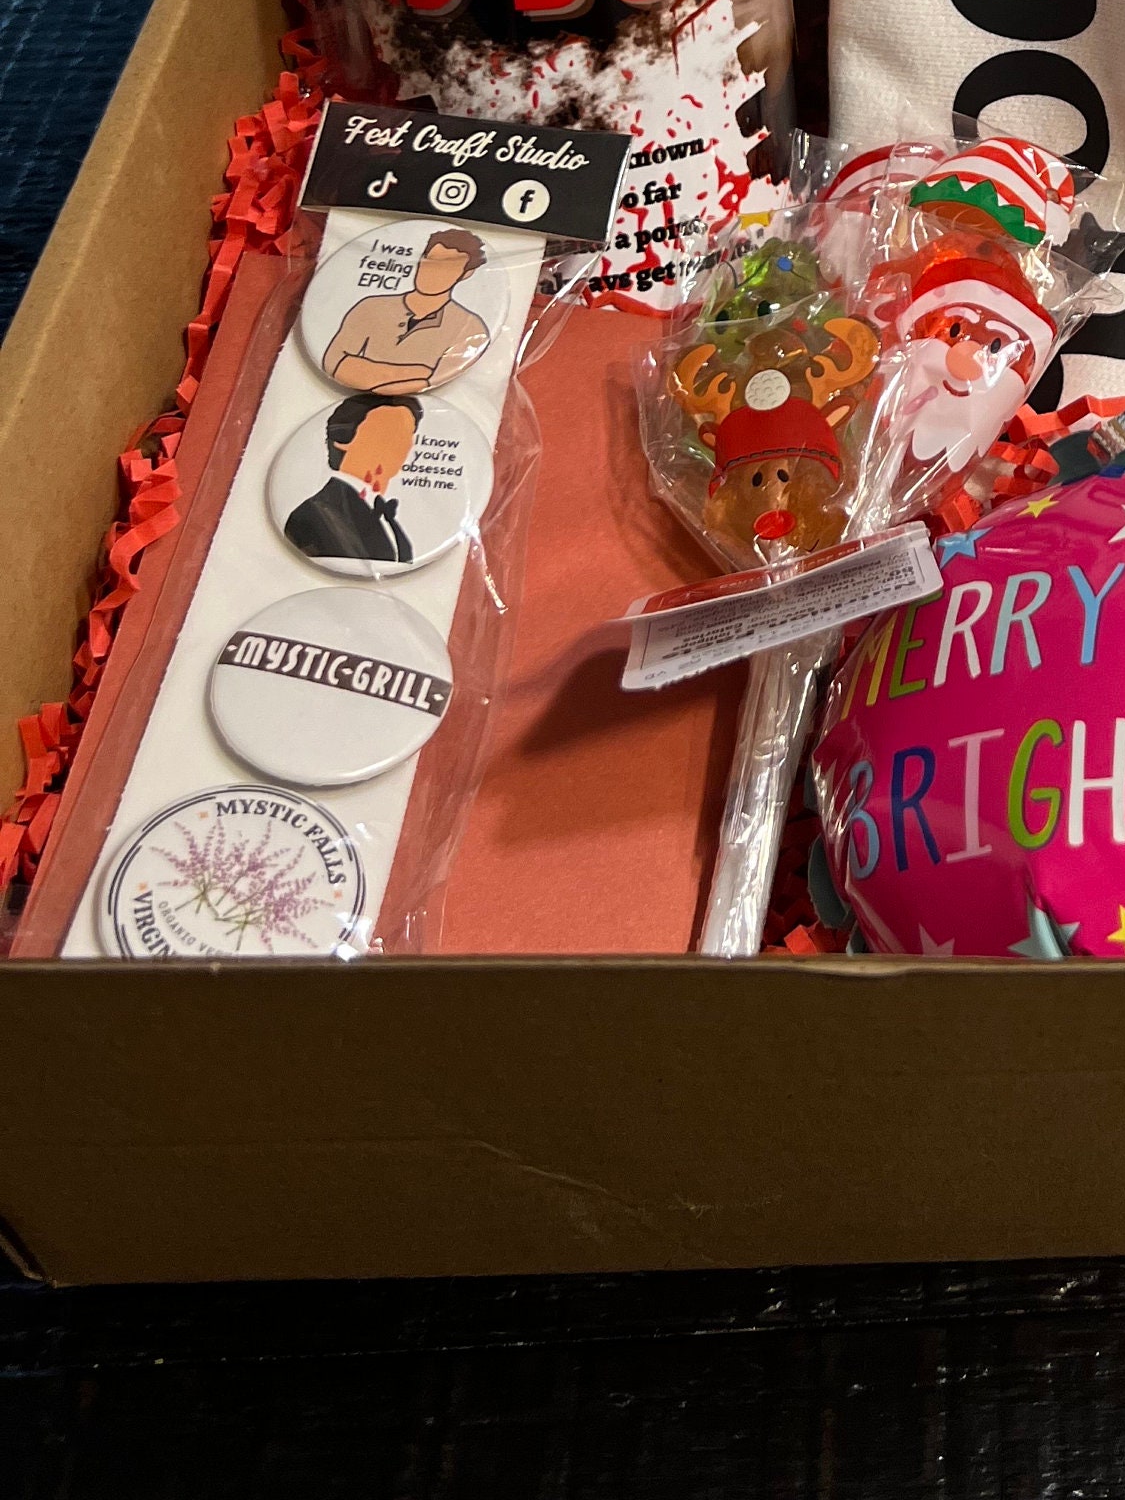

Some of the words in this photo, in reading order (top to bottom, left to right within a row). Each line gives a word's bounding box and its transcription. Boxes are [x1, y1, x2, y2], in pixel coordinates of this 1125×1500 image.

[344, 115, 413, 149] Fest
[412, 123, 498, 168] Craft
[495, 134, 590, 171] Studio
[642, 181, 682, 206] far
[371, 238, 379, 253] I
[380, 242, 414, 258] was
[614, 232, 632, 251] a
[358, 256, 414, 278] feeling
[636, 260, 677, 293] get
[357, 272, 402, 292] EPIC!
[421, 435, 460, 449] know
[401, 462, 464, 477] obsessed
[401, 476, 431, 489] with
[433, 479, 458, 491] me.
[215, 798, 309, 830] MYSTIC
[303, 822, 347, 886] FALLS
